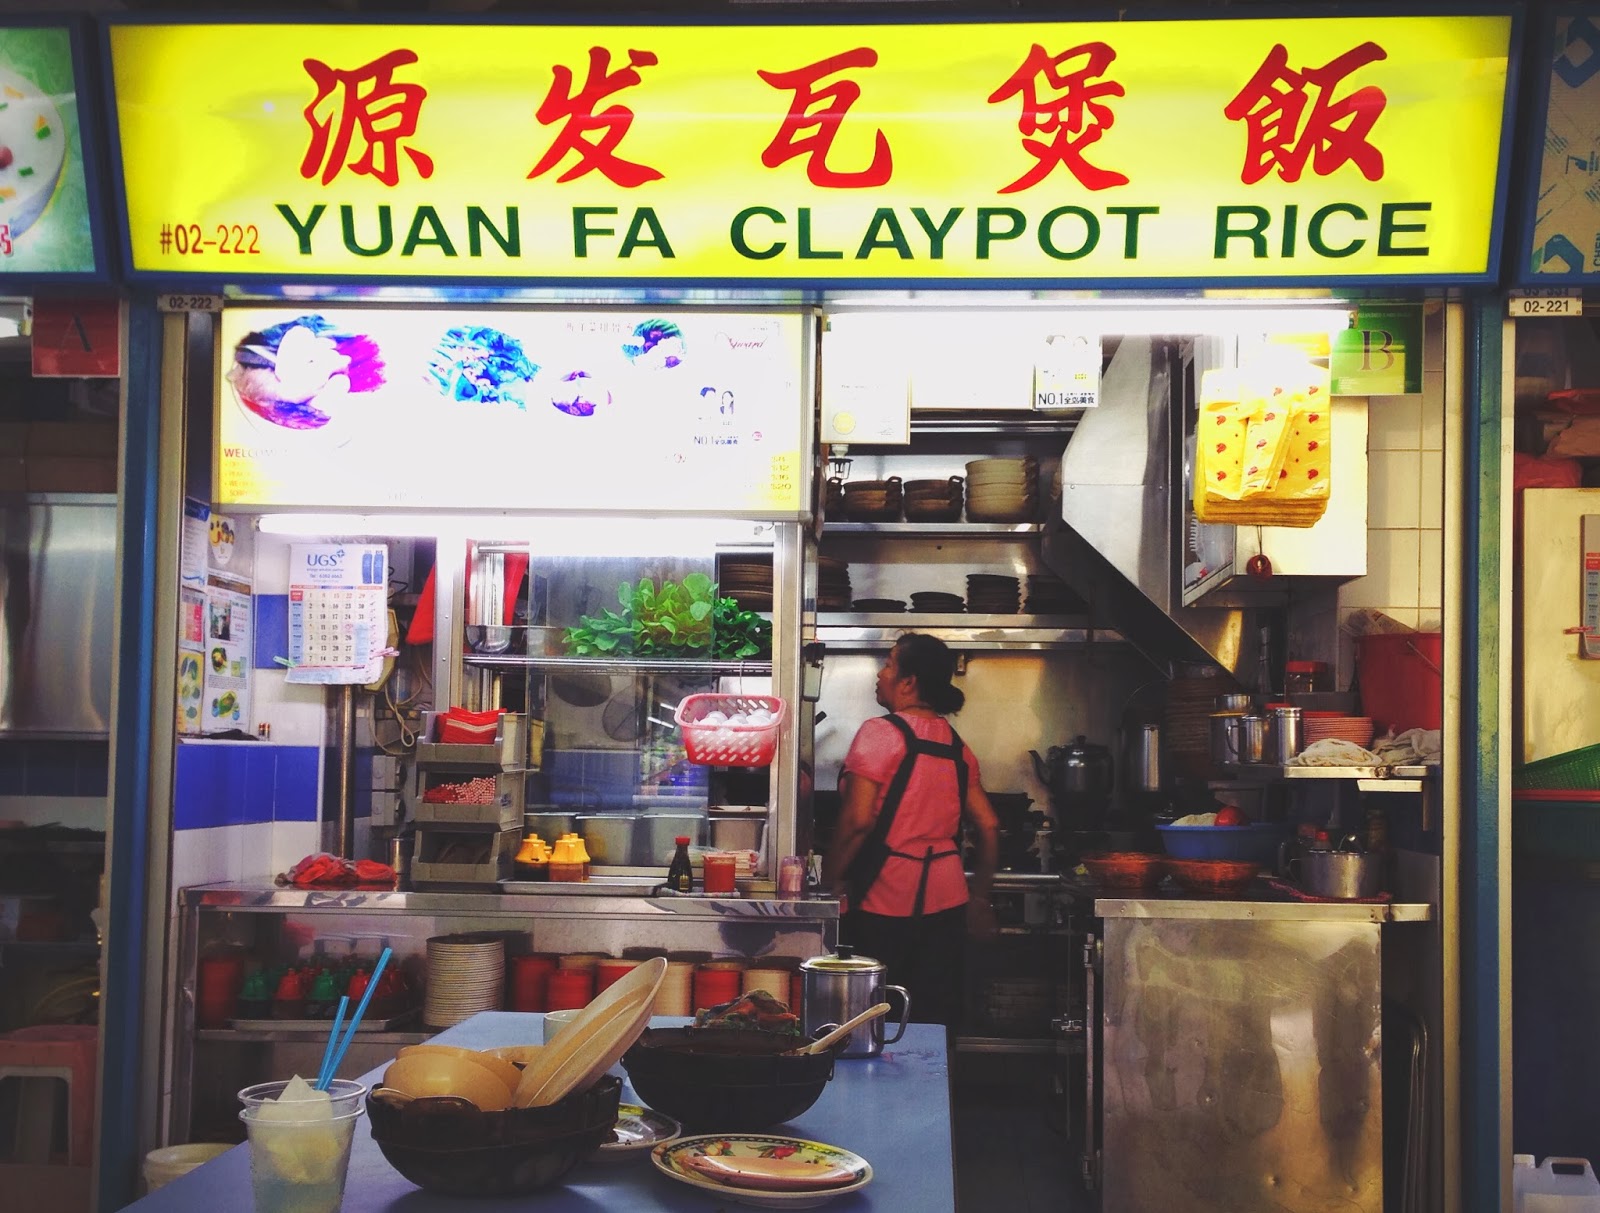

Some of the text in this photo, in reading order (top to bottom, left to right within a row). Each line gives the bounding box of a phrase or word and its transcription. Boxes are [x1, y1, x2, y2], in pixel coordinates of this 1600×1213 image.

[160, 223, 261, 256] #02-222
[276, 202, 1432, 260] YUAN FA CLAYPOT RICE
[169, 297, 212, 309] 02-222
[1523, 300, 1569, 313] 02-221
[1357, 329, 1395, 371] B
[307, 554, 338, 566] UGS
